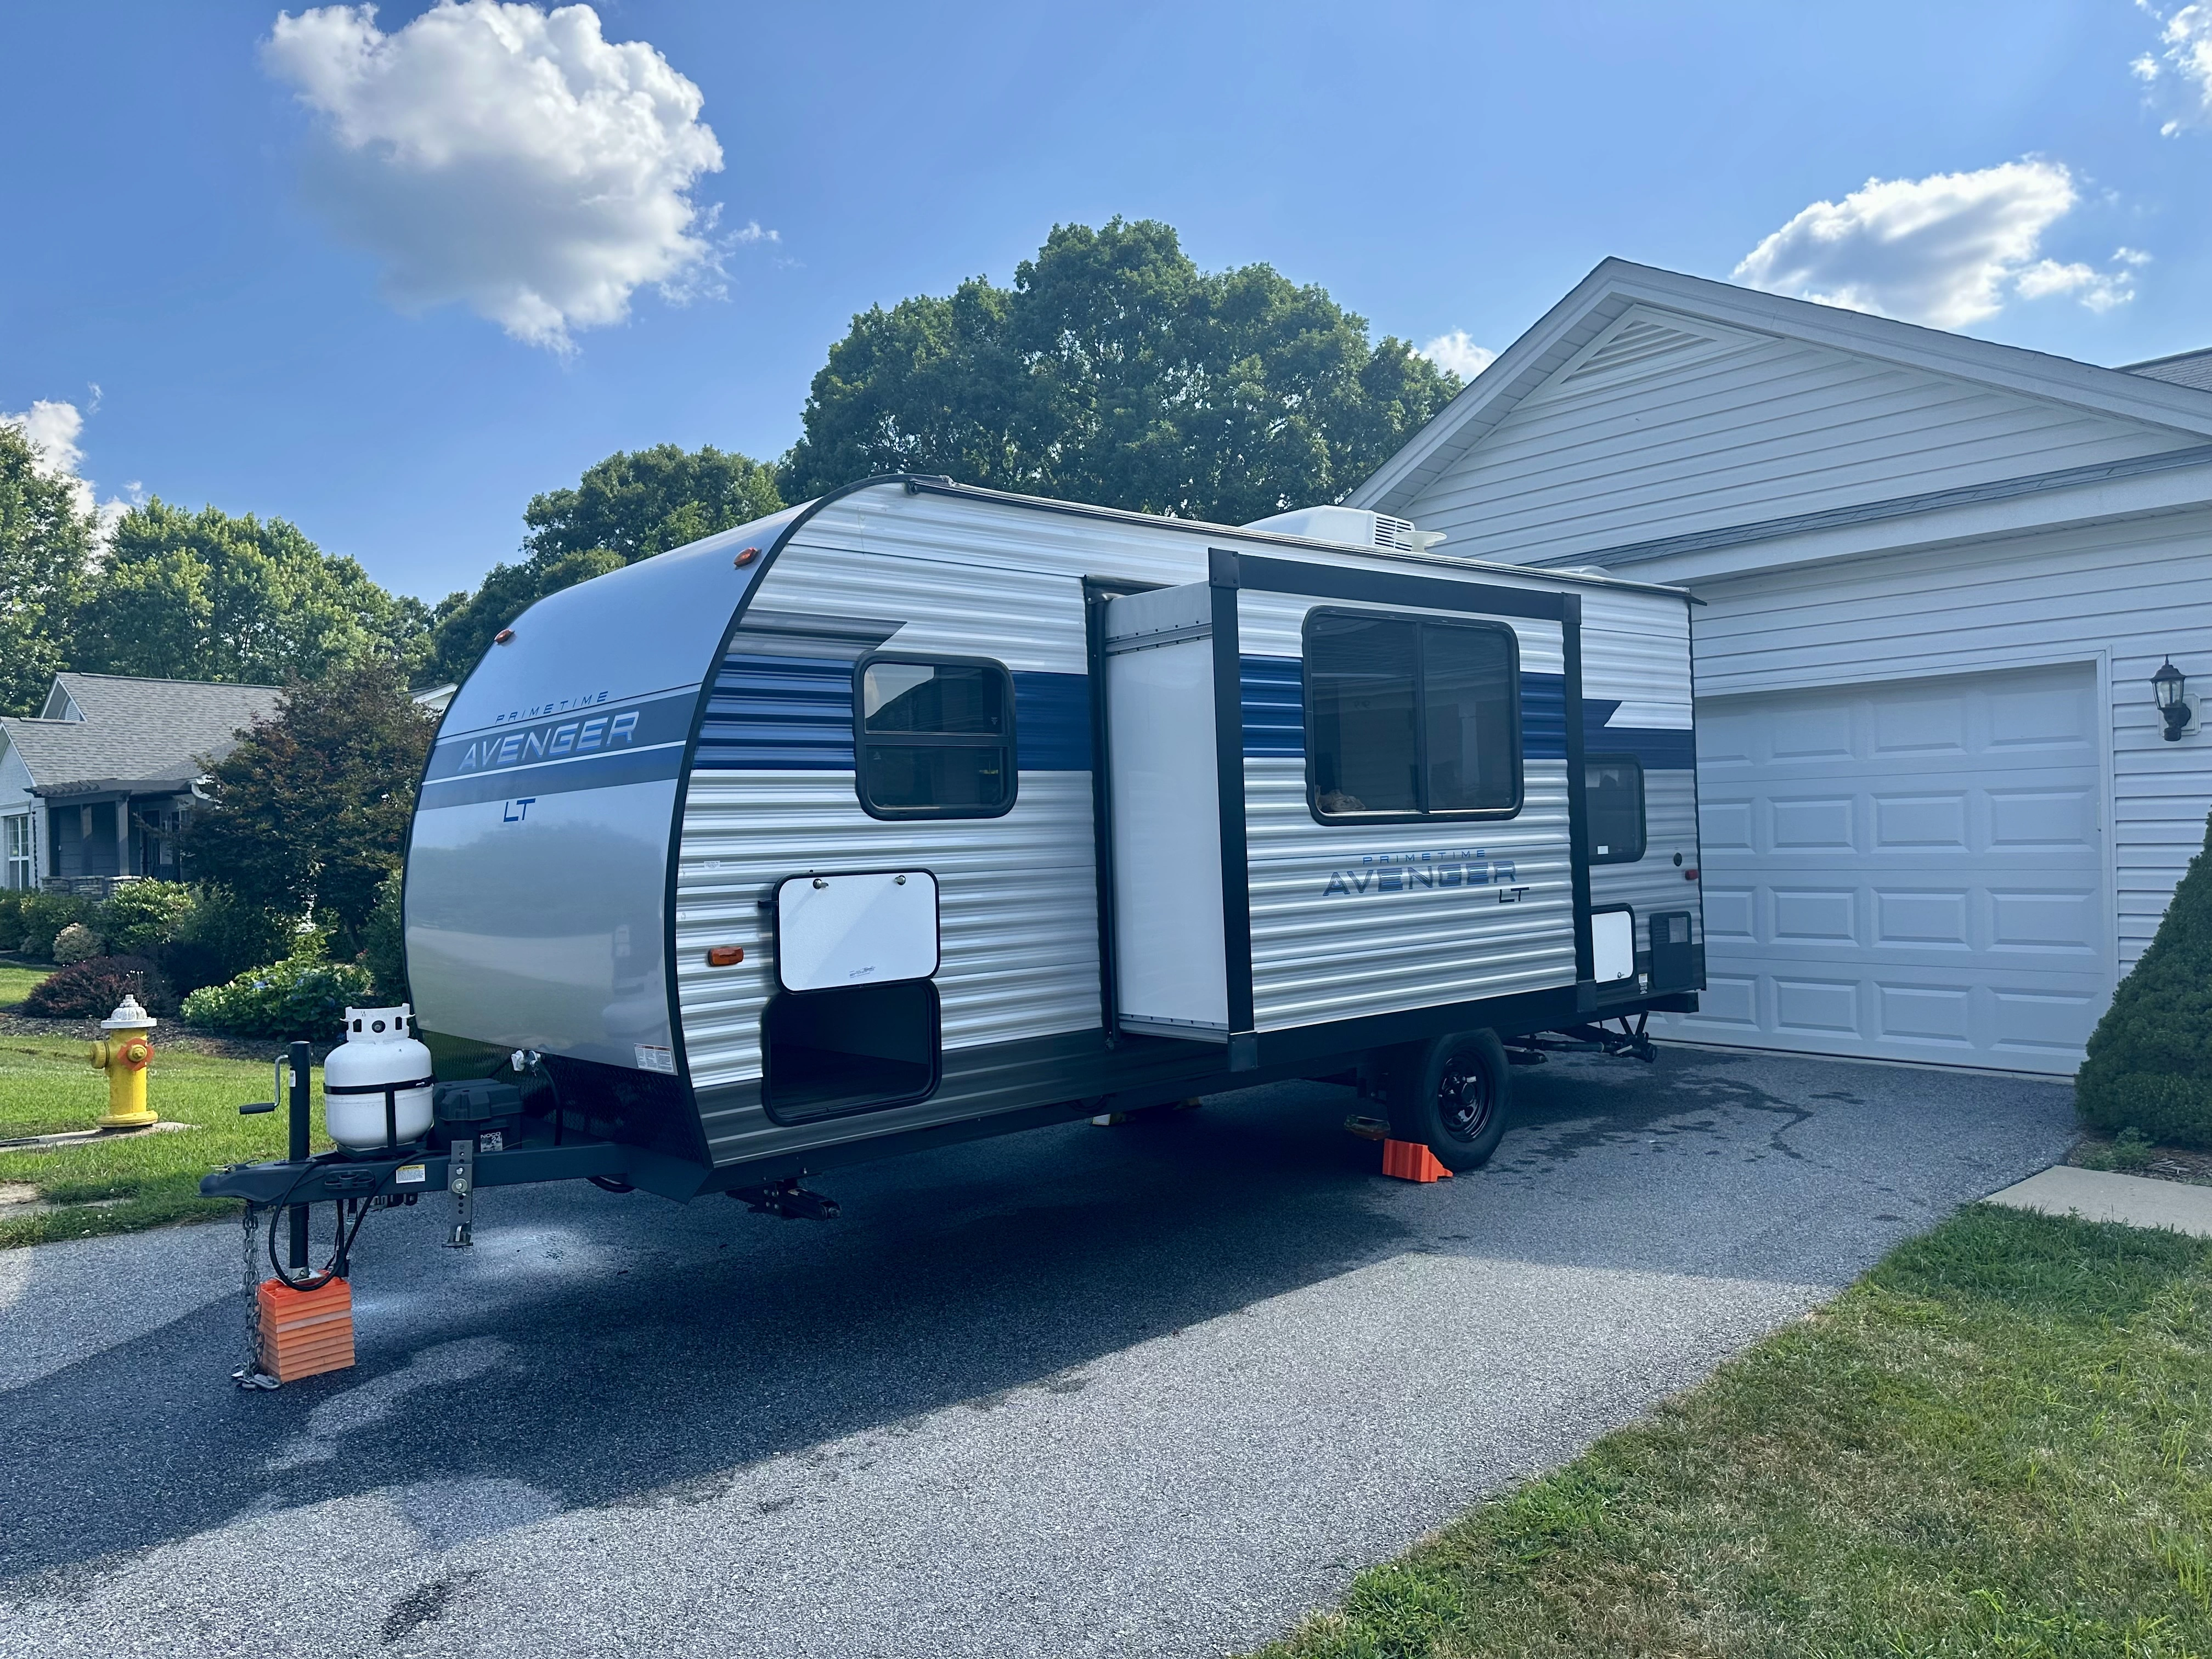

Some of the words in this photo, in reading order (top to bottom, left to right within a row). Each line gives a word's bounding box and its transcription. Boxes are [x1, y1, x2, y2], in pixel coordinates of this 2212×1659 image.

[495, 691, 610, 725] PRIMETIME
[458, 711, 640, 772] AVENGER
[503, 798, 537, 823] LT
[1362, 849, 1486, 865] PRIMETIME
[1322, 861, 1516, 896] AVENGER
[1499, 887, 1530, 904] LT
